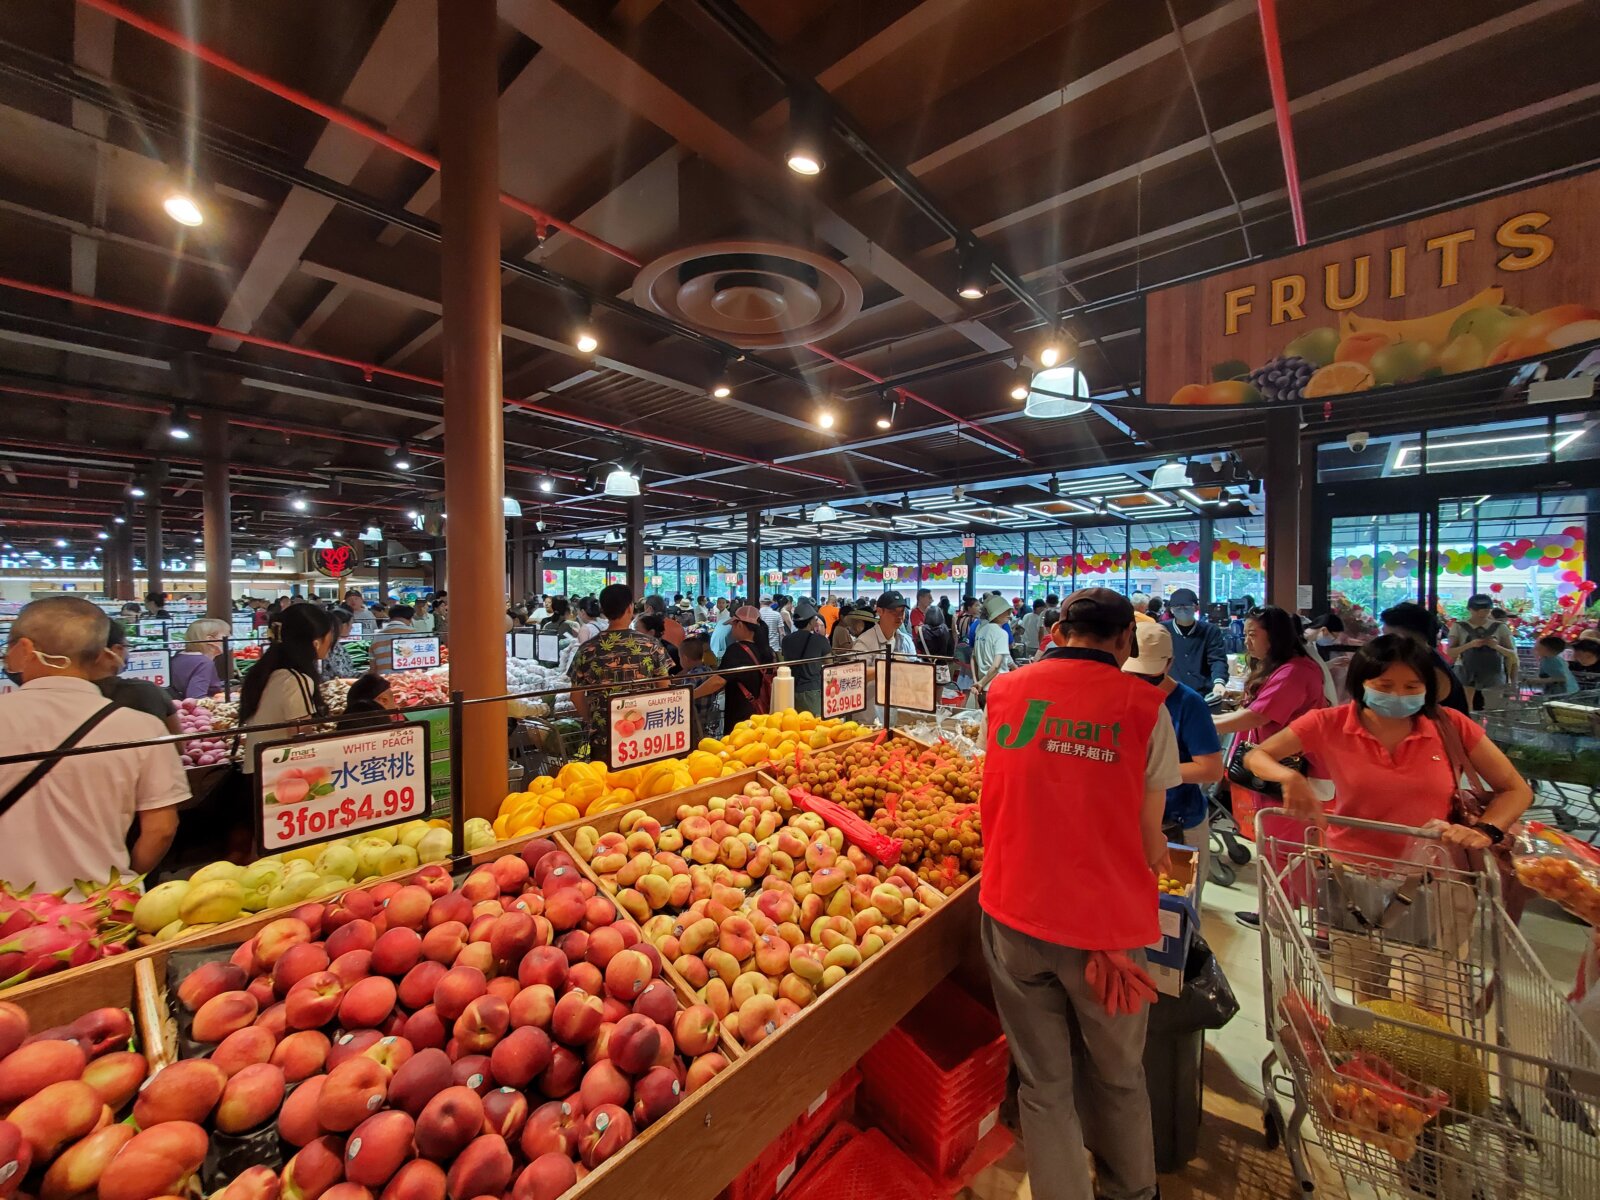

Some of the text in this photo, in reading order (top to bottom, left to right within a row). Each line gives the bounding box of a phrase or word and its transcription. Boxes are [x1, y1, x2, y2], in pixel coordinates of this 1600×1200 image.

[1224, 212, 1555, 336] FRUITS
[396, 655, 436, 668] $2.49/LB
[647, 698, 667, 707] GALAXY
[667, 696, 683, 704] PEACH
[826, 693, 862, 714] $2.99/LB
[643, 706, 685, 731] 扁桃
[342, 735, 414, 756] WHITE PEACH
[617, 730, 686, 764] $3.99/LB
[1045, 739, 1115, 763] 新世界超市
[331, 751, 415, 790] 水蜜桃
[276, 785, 415, 841] 3for$4.99
